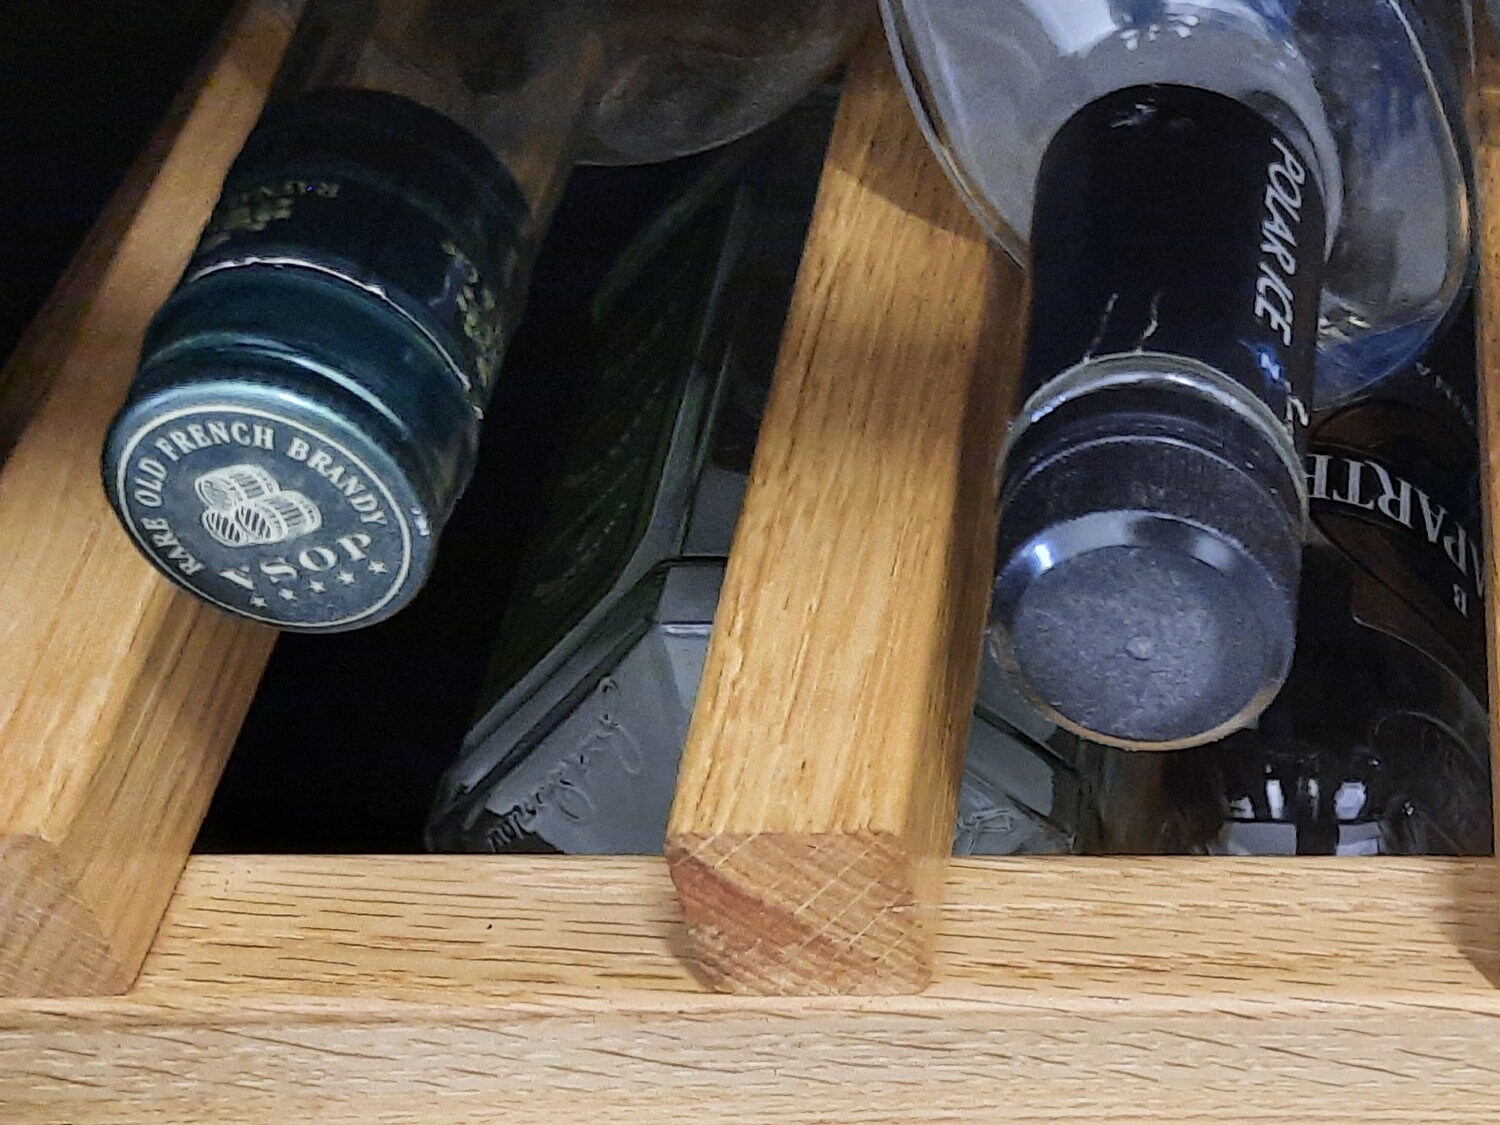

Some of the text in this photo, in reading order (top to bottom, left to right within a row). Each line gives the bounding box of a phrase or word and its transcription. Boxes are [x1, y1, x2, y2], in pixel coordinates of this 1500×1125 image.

[134, 420, 388, 577] RARE OLD FRENCH BRANDY
[219, 532, 373, 590] VSOP
